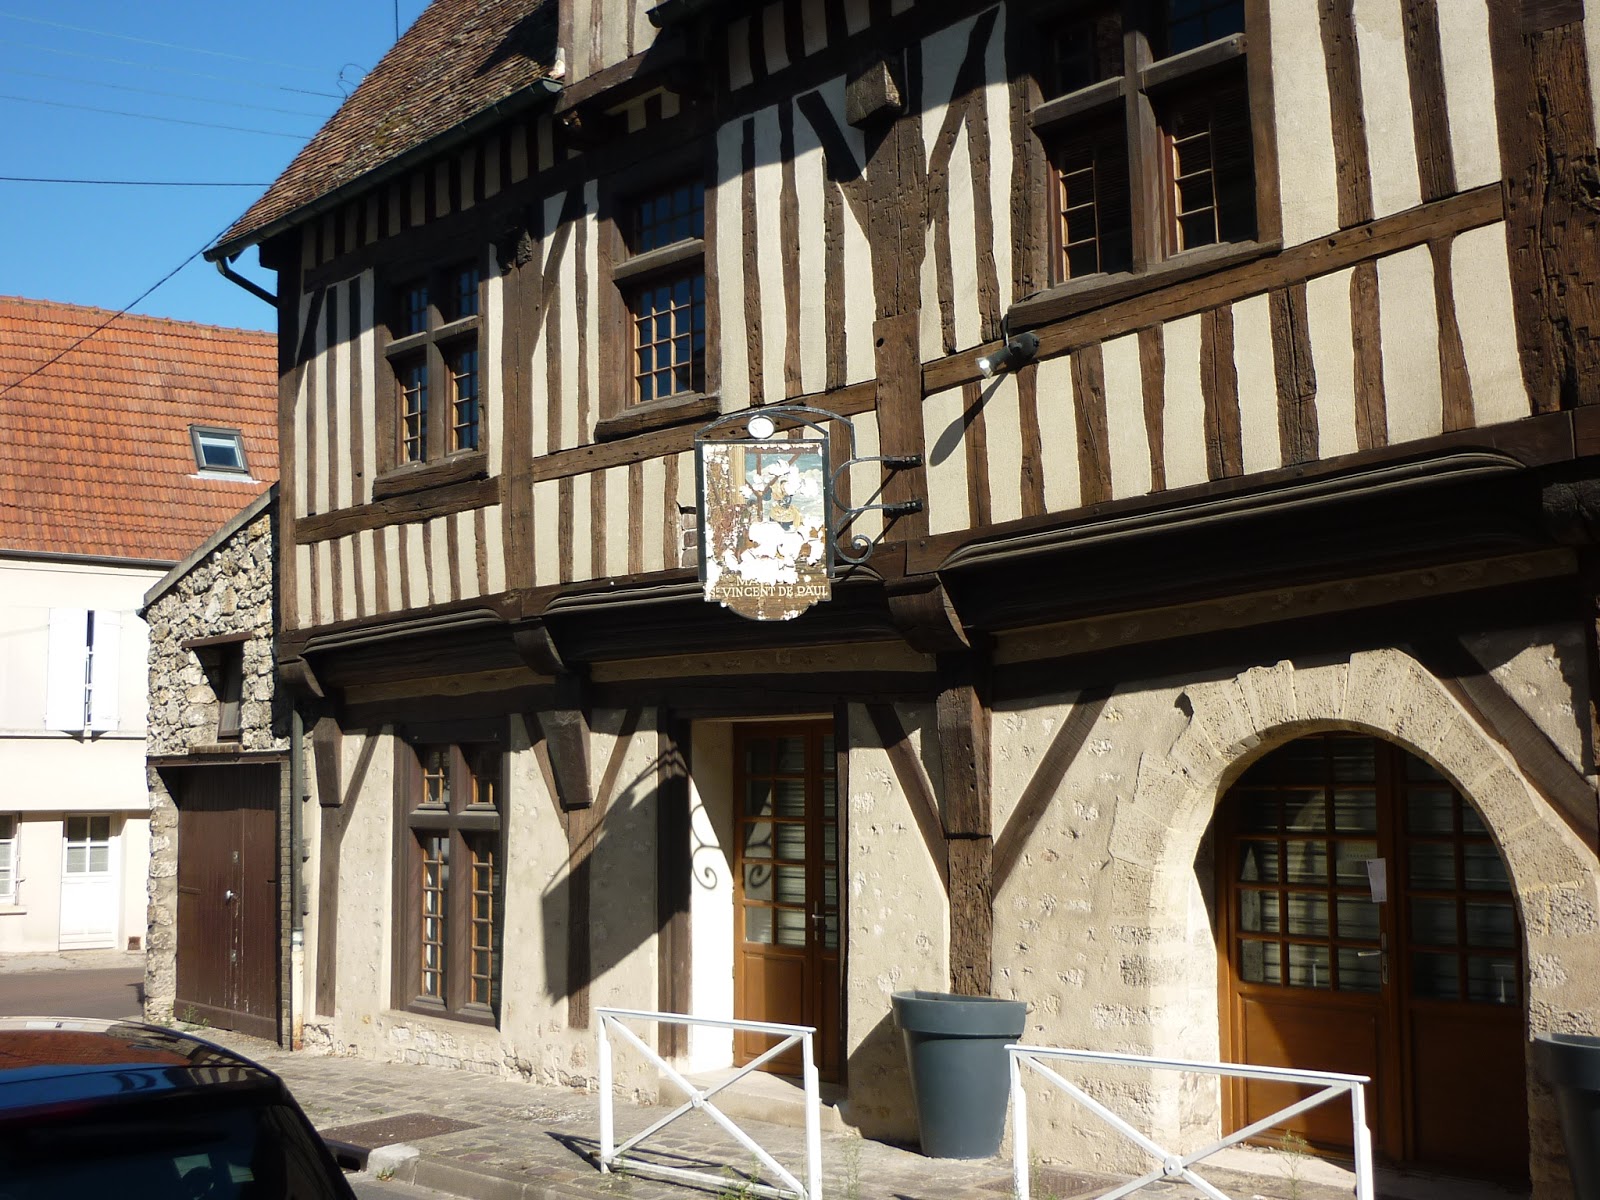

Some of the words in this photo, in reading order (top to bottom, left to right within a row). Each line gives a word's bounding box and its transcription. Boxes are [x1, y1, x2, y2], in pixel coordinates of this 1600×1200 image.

[722, 587, 775, 597] VINCENT
[778, 587, 794, 597] DE
[797, 585, 828, 596] PAUL
